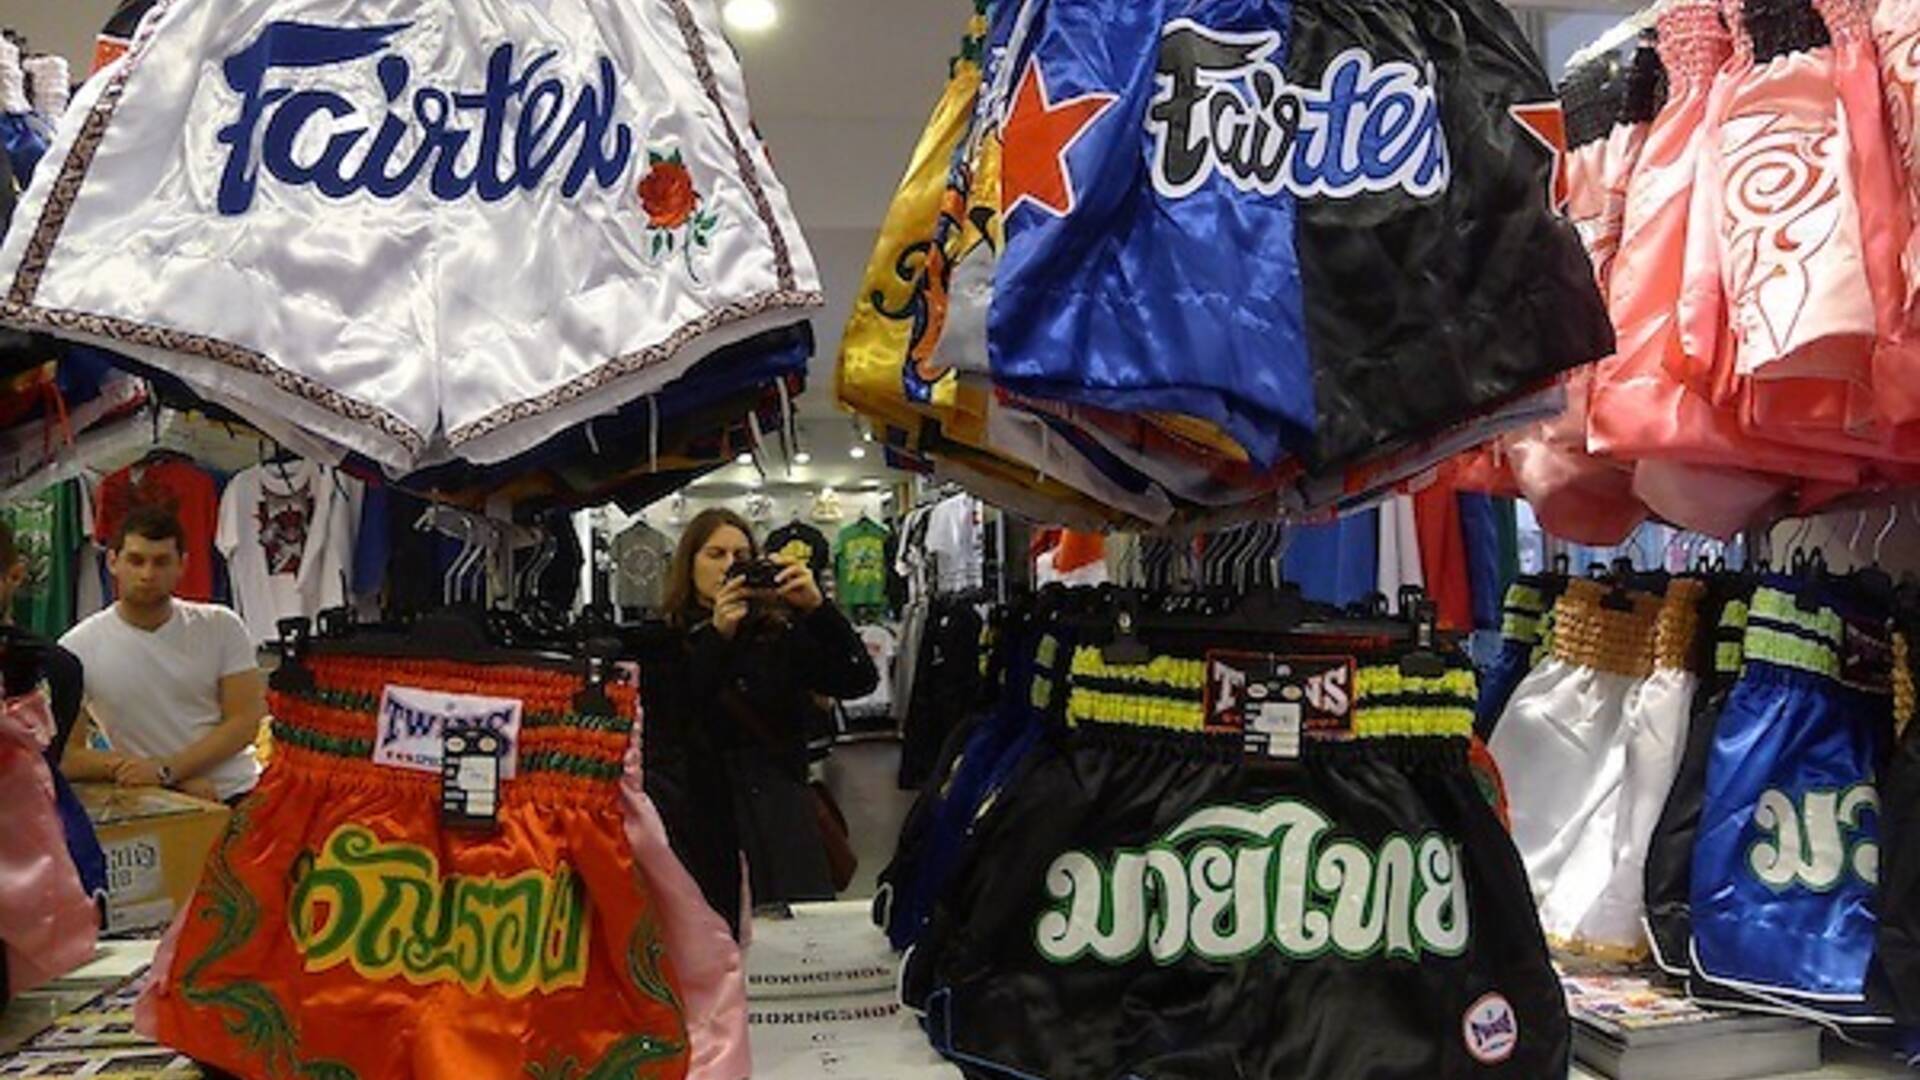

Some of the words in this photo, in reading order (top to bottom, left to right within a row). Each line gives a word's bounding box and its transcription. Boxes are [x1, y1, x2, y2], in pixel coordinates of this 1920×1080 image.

[217, 20, 632, 216] Fairtex
[382, 694, 513, 757] TWS
[1212, 661, 1349, 717] TNS
[1035, 797, 1469, 966] มวยไทย
